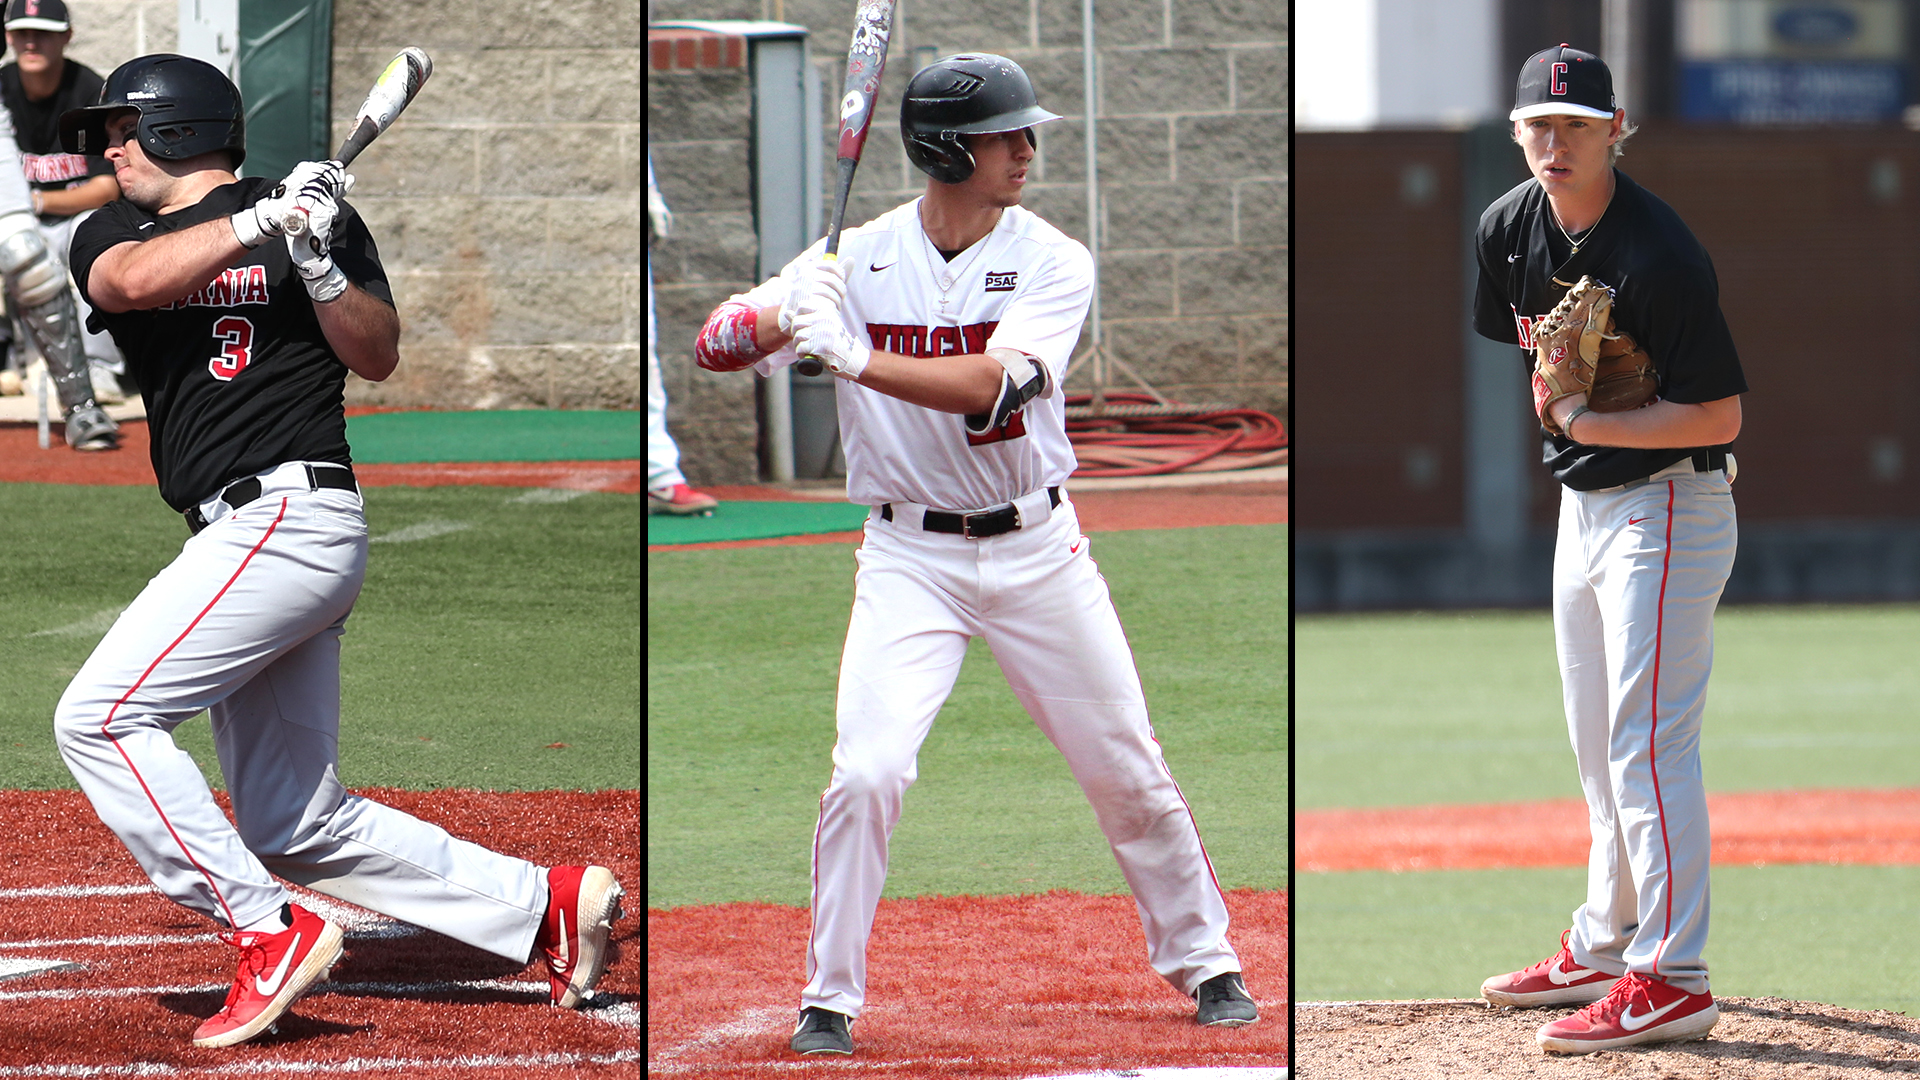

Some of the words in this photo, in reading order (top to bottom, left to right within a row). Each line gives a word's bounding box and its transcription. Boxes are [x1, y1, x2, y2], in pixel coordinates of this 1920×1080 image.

[1551, 62, 1568, 95] C
[127, 91, 157, 100] Wilson
[985, 276, 1018, 287] PSAC
[208, 315, 254, 381] 3
